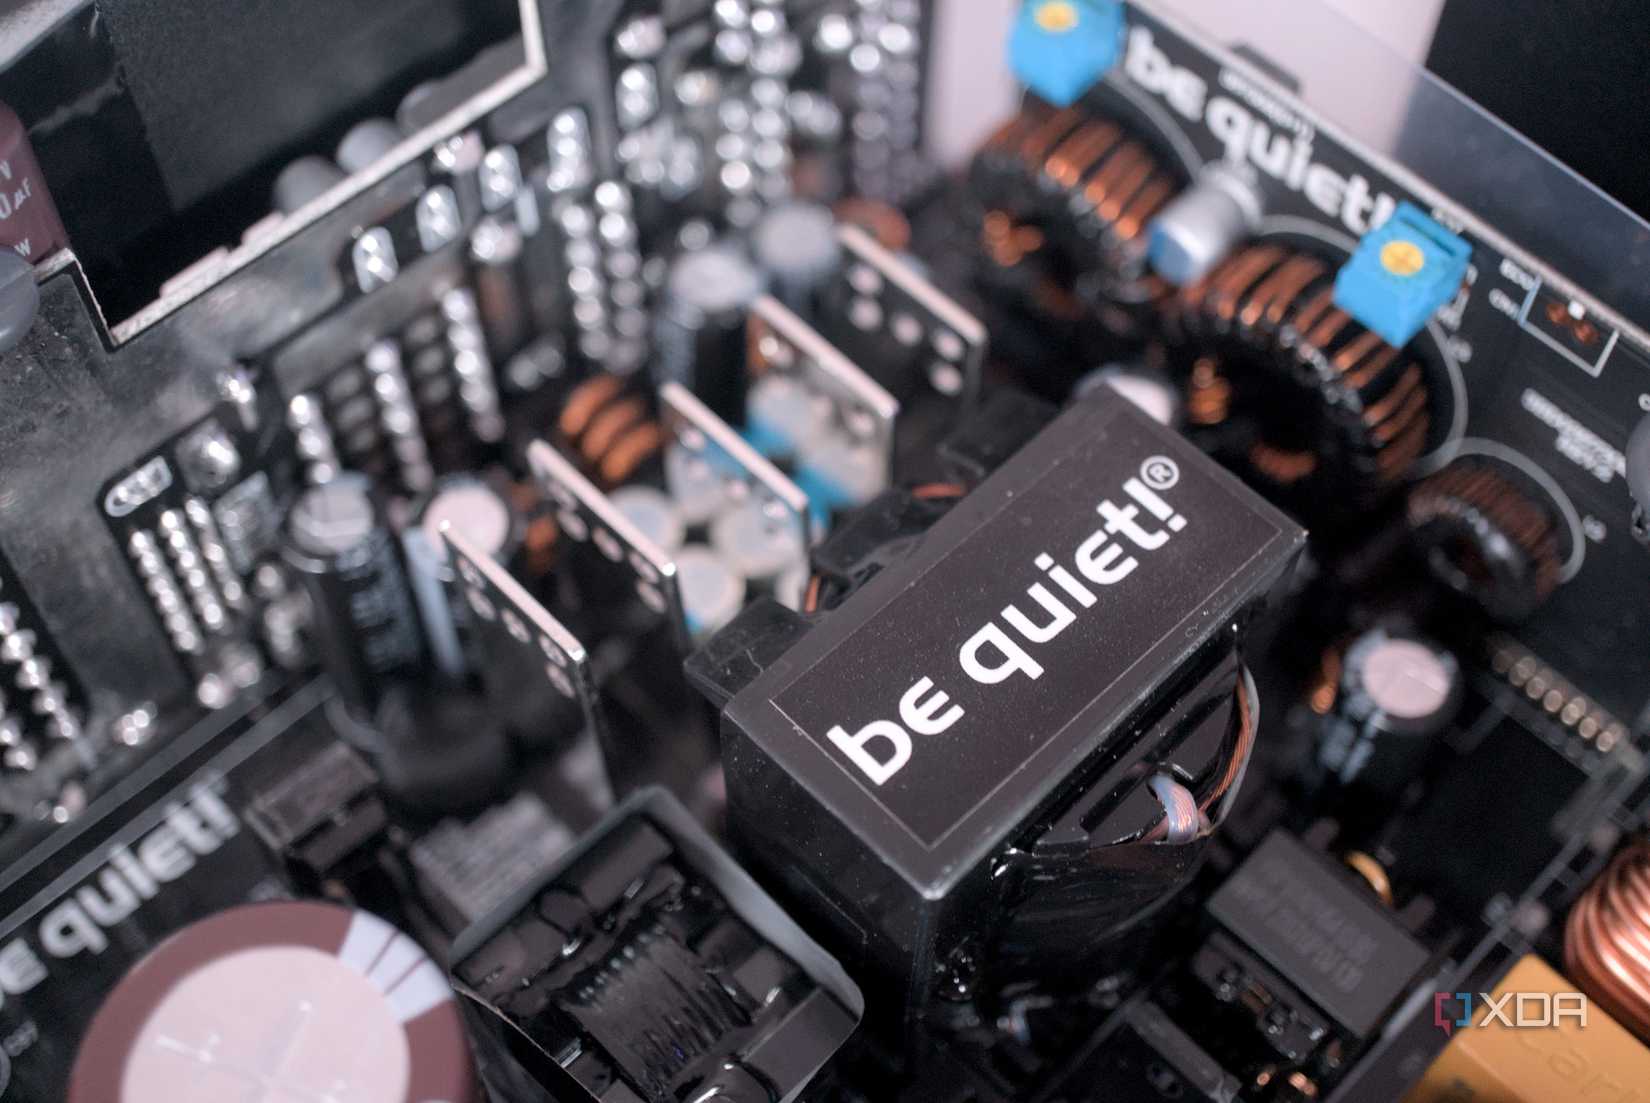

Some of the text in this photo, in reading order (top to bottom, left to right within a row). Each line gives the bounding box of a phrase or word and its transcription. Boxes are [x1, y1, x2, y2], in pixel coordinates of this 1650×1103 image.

[1124, 26, 1207, 122] be
[827, 676, 965, 786] be
[0, 937, 48, 1010] e
